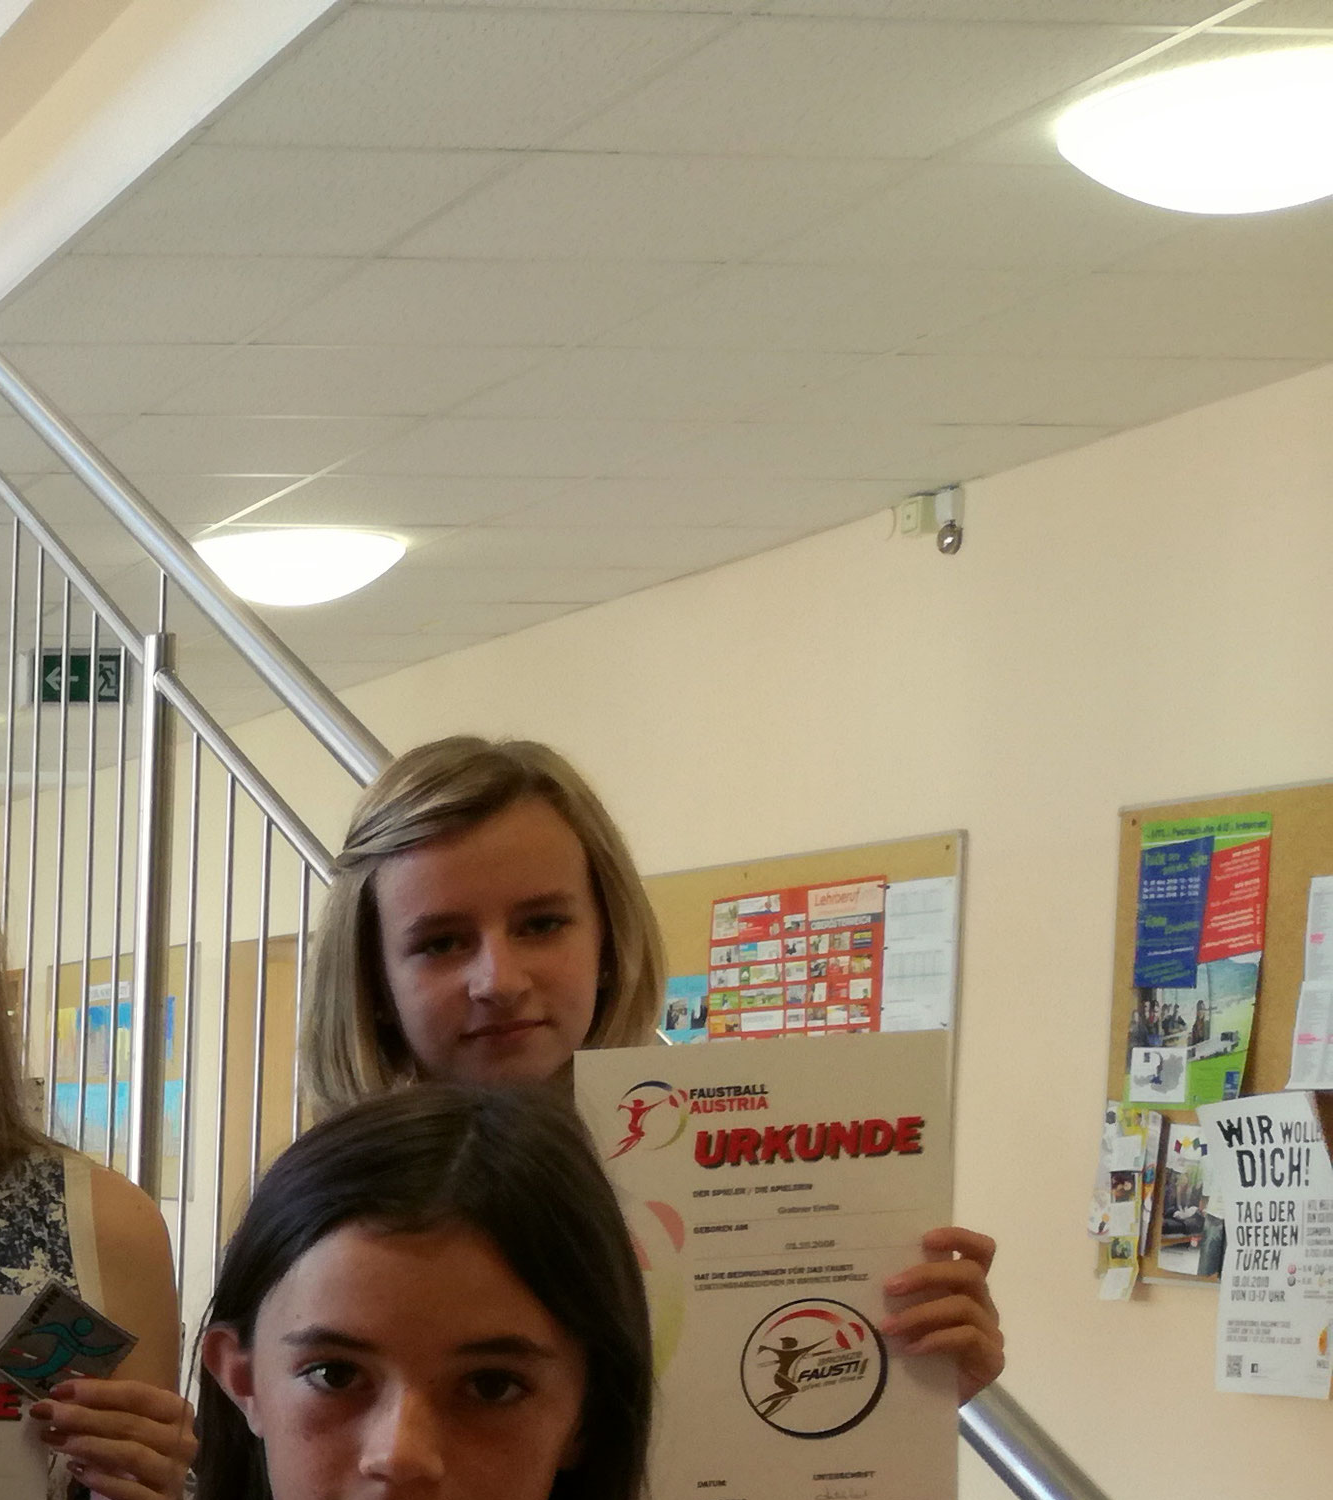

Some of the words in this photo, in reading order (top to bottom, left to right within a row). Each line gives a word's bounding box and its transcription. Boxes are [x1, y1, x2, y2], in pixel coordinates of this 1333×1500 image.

[690, 1083, 769, 1099] FAUSTBALL
[689, 1096, 769, 1115] AUSTRIA
[692, 1116, 926, 1169] URKUNDE
[1216, 1115, 1274, 1148] WIR
[1236, 1147, 1310, 1187] DICH!
[1236, 1201, 1263, 1223] TAG
[1269, 1200, 1295, 1222] DER
[1236, 1225, 1298, 1247] OFFENEN
